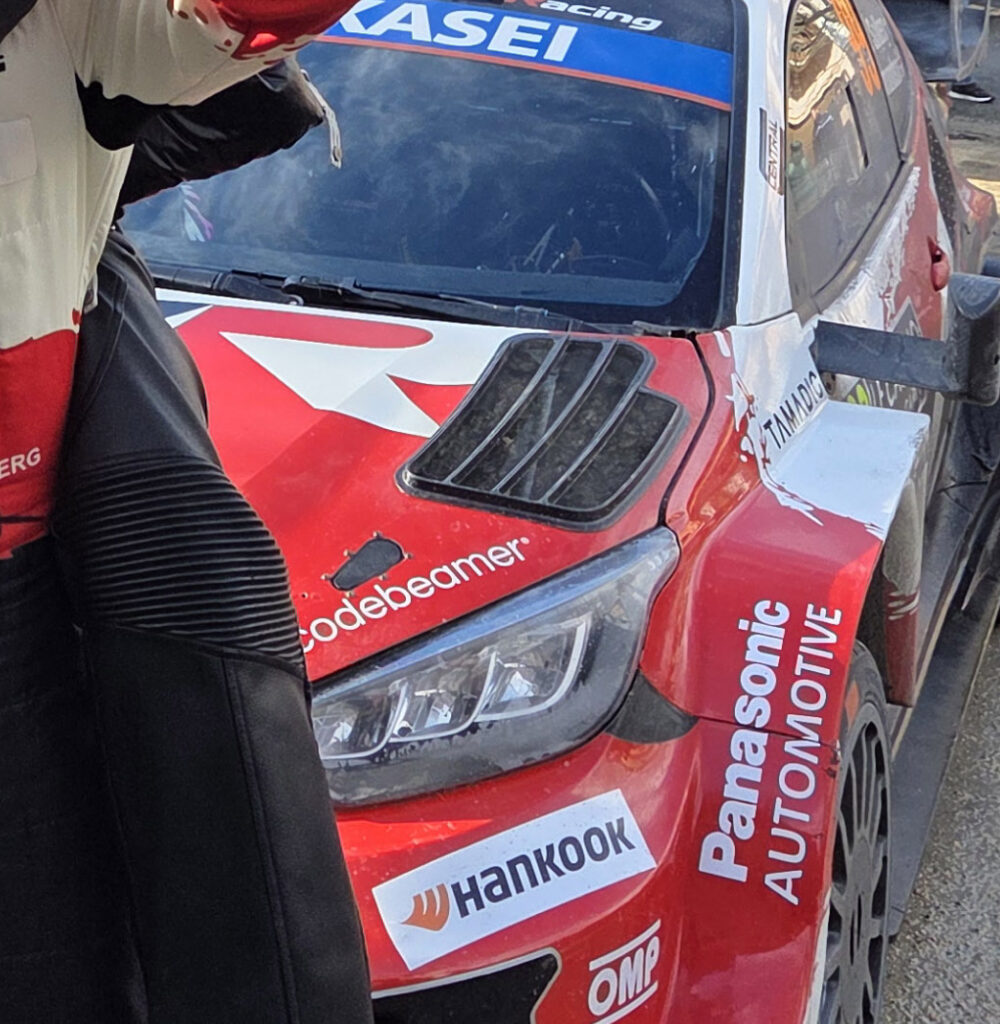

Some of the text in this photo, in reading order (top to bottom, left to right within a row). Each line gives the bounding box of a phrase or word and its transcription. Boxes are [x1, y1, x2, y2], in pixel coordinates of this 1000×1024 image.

[763, 370, 825, 450] TAMADIC
[698, 599, 790, 883] Panasonic
[763, 603, 842, 906] AUTOMOTIVE
[587, 935, 661, 1017] OMP
